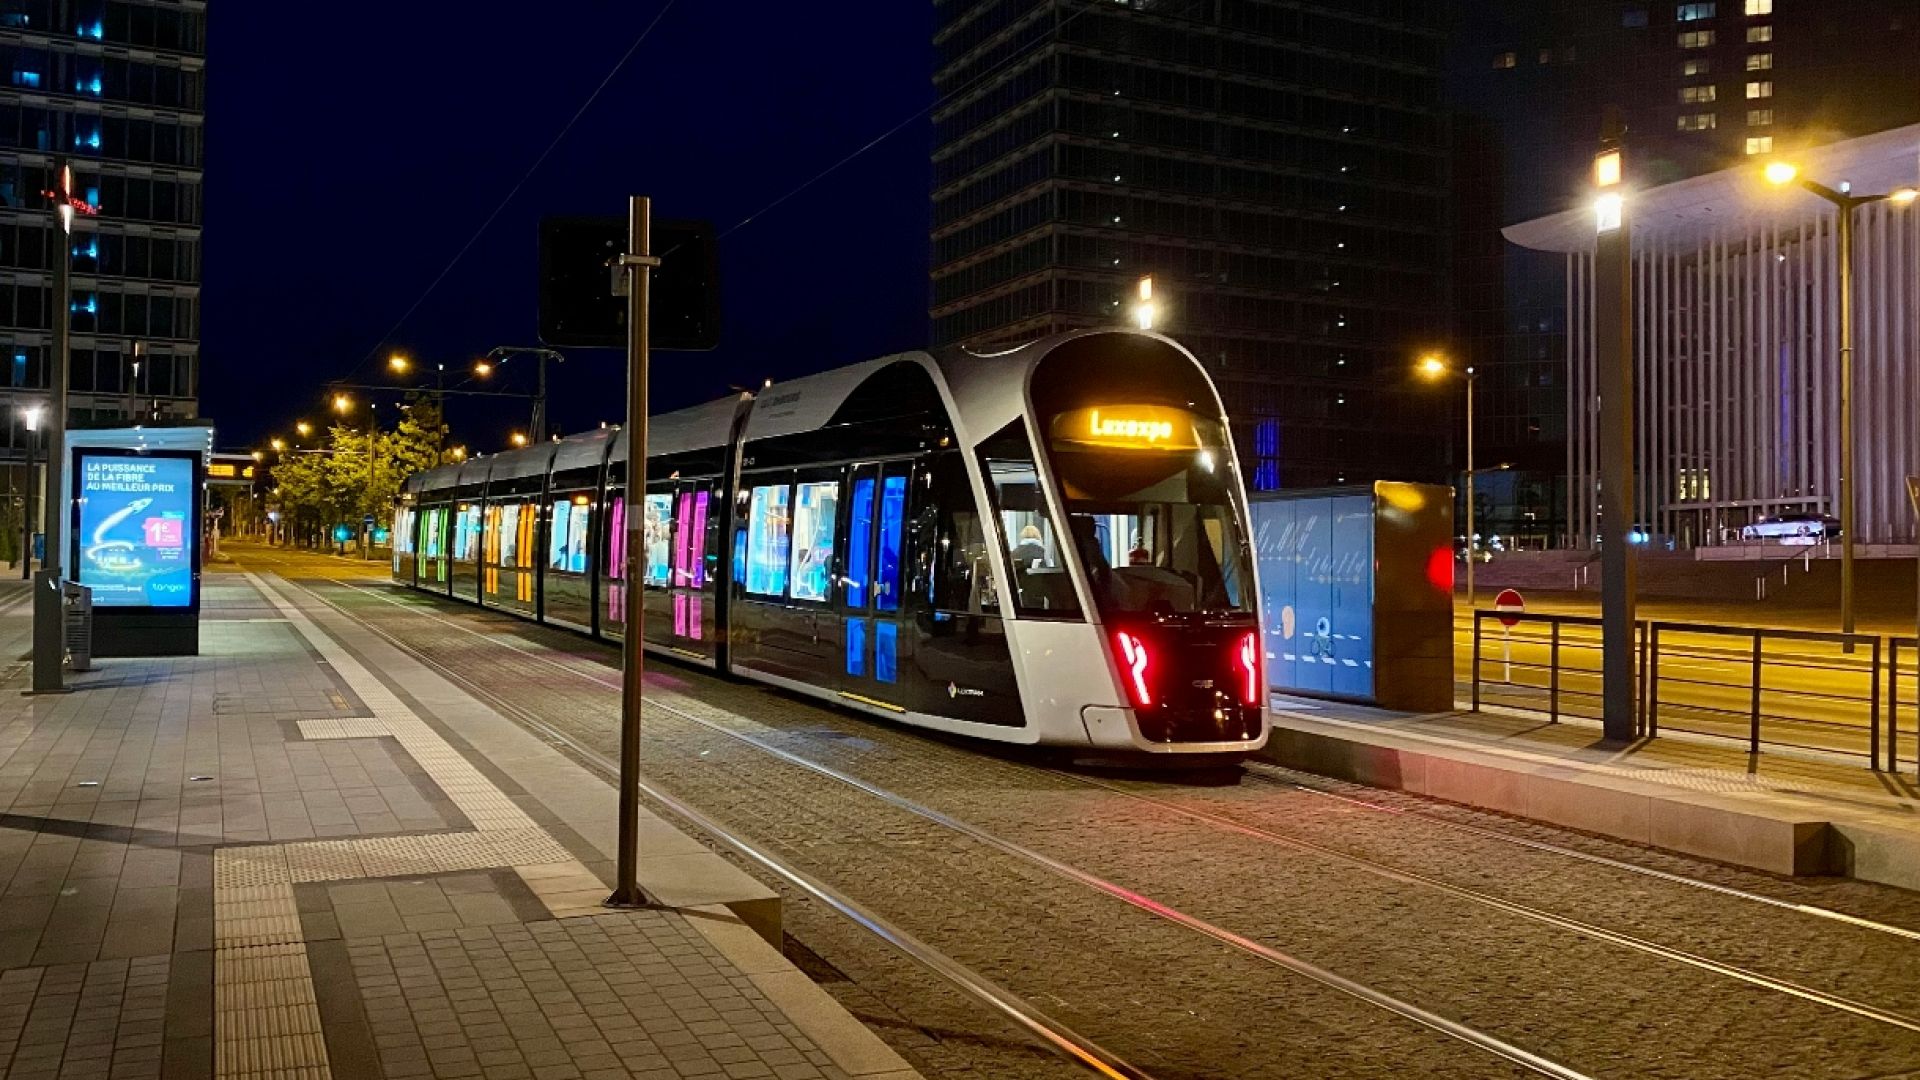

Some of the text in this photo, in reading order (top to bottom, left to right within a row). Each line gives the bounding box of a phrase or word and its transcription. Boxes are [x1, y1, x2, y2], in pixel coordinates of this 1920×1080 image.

[1090, 409, 1172, 442] Luxexpo
[87, 463, 156, 473] LA PUISSANCE
[87, 473, 145, 482] DE LA FIBRE
[86, 482, 175, 493] AU MEILLEUR PRIX
